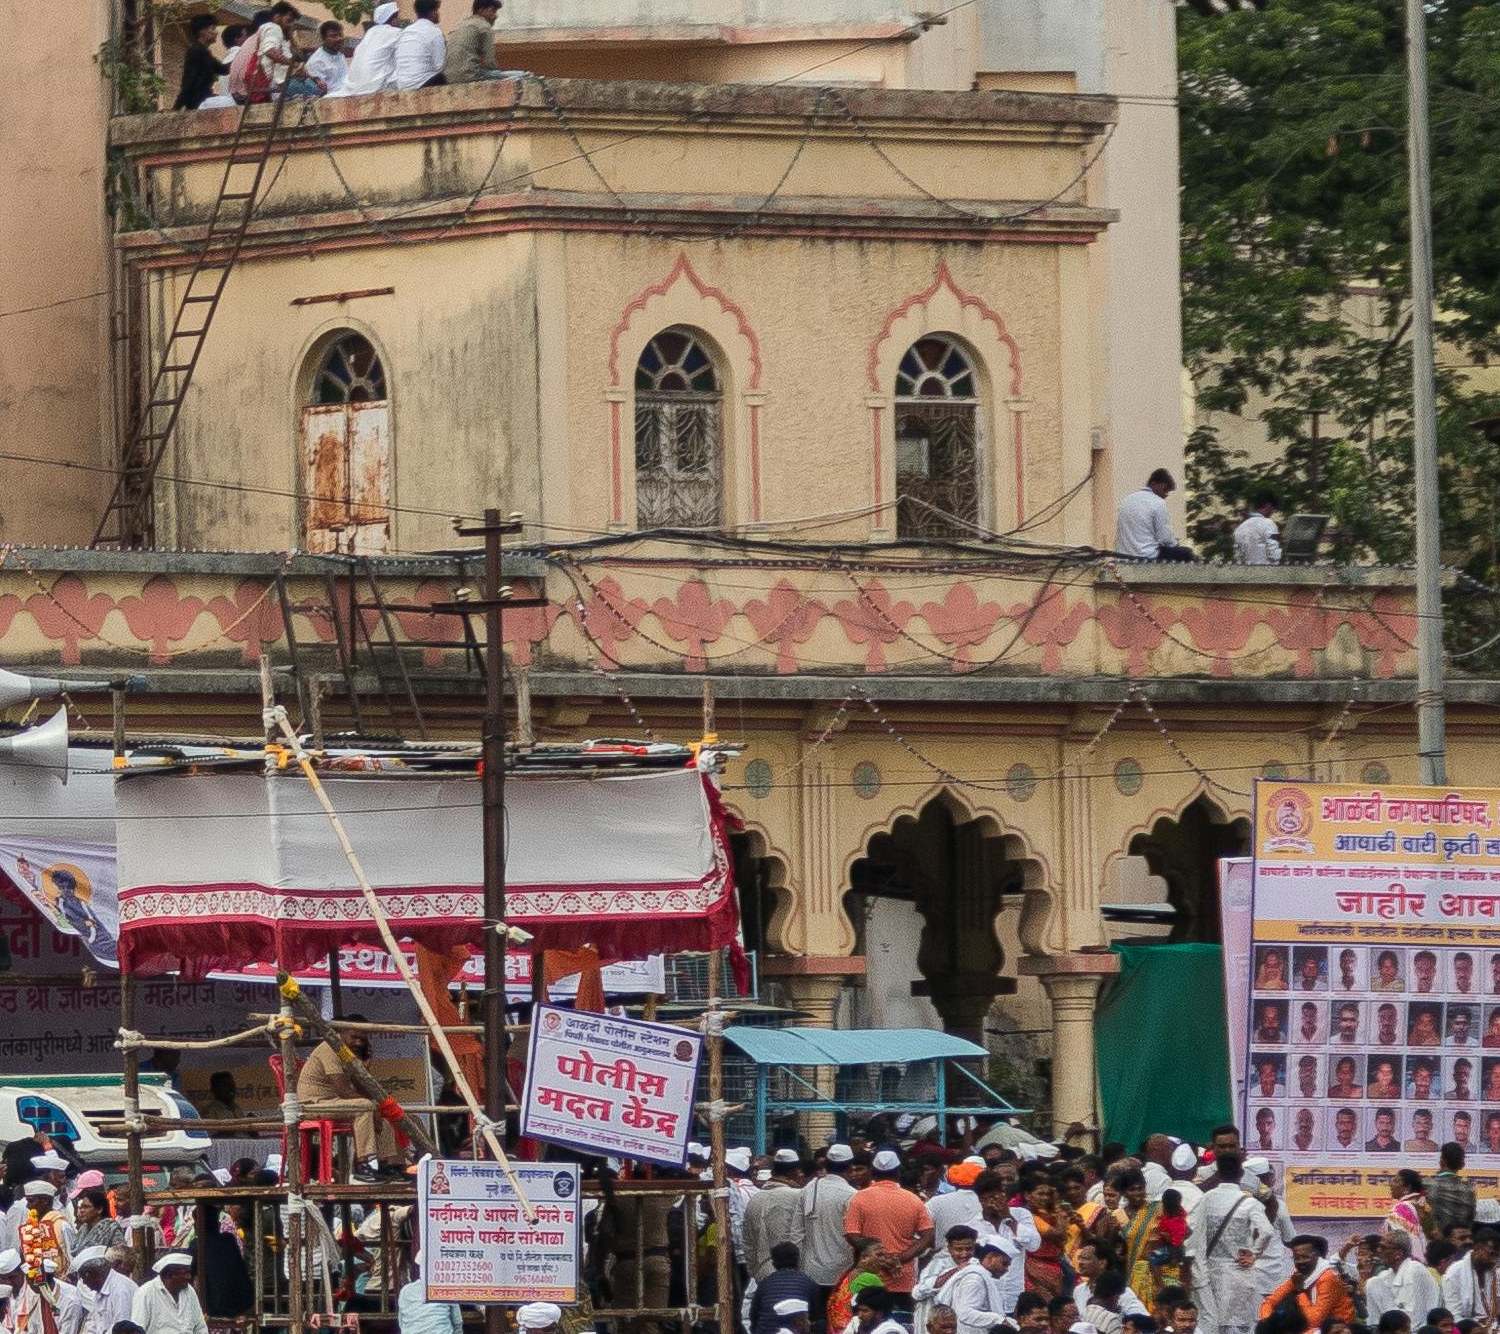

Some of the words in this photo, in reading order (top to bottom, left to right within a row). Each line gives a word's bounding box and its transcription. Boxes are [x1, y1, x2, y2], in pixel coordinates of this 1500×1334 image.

[1321, 790, 1382, 823] आळंदी
[1334, 830, 1397, 853] आषाढी
[1402, 832, 1437, 855] वारी
[1441, 833, 1480, 860] कृती
[1336, 882, 1427, 919] जाहीर
[603, 1022, 637, 1041] पोलीस
[556, 1049, 669, 1098] पोलीस
[537, 1086, 614, 1122] मदत
[621, 1094, 679, 1139] केंद्र
[429, 1202, 480, 1226] गर्दीमध्ये
[483, 1203, 519, 1224] आपले
[563, 1210, 575, 1224] व
[440, 1225, 475, 1245] आपले
[478, 1225, 516, 1245] पाकीट
[518, 1226, 565, 1246] सांभाळा
[434, 1260, 494, 1272] 02027352600
[434, 1273, 494, 1285] 02027352500
